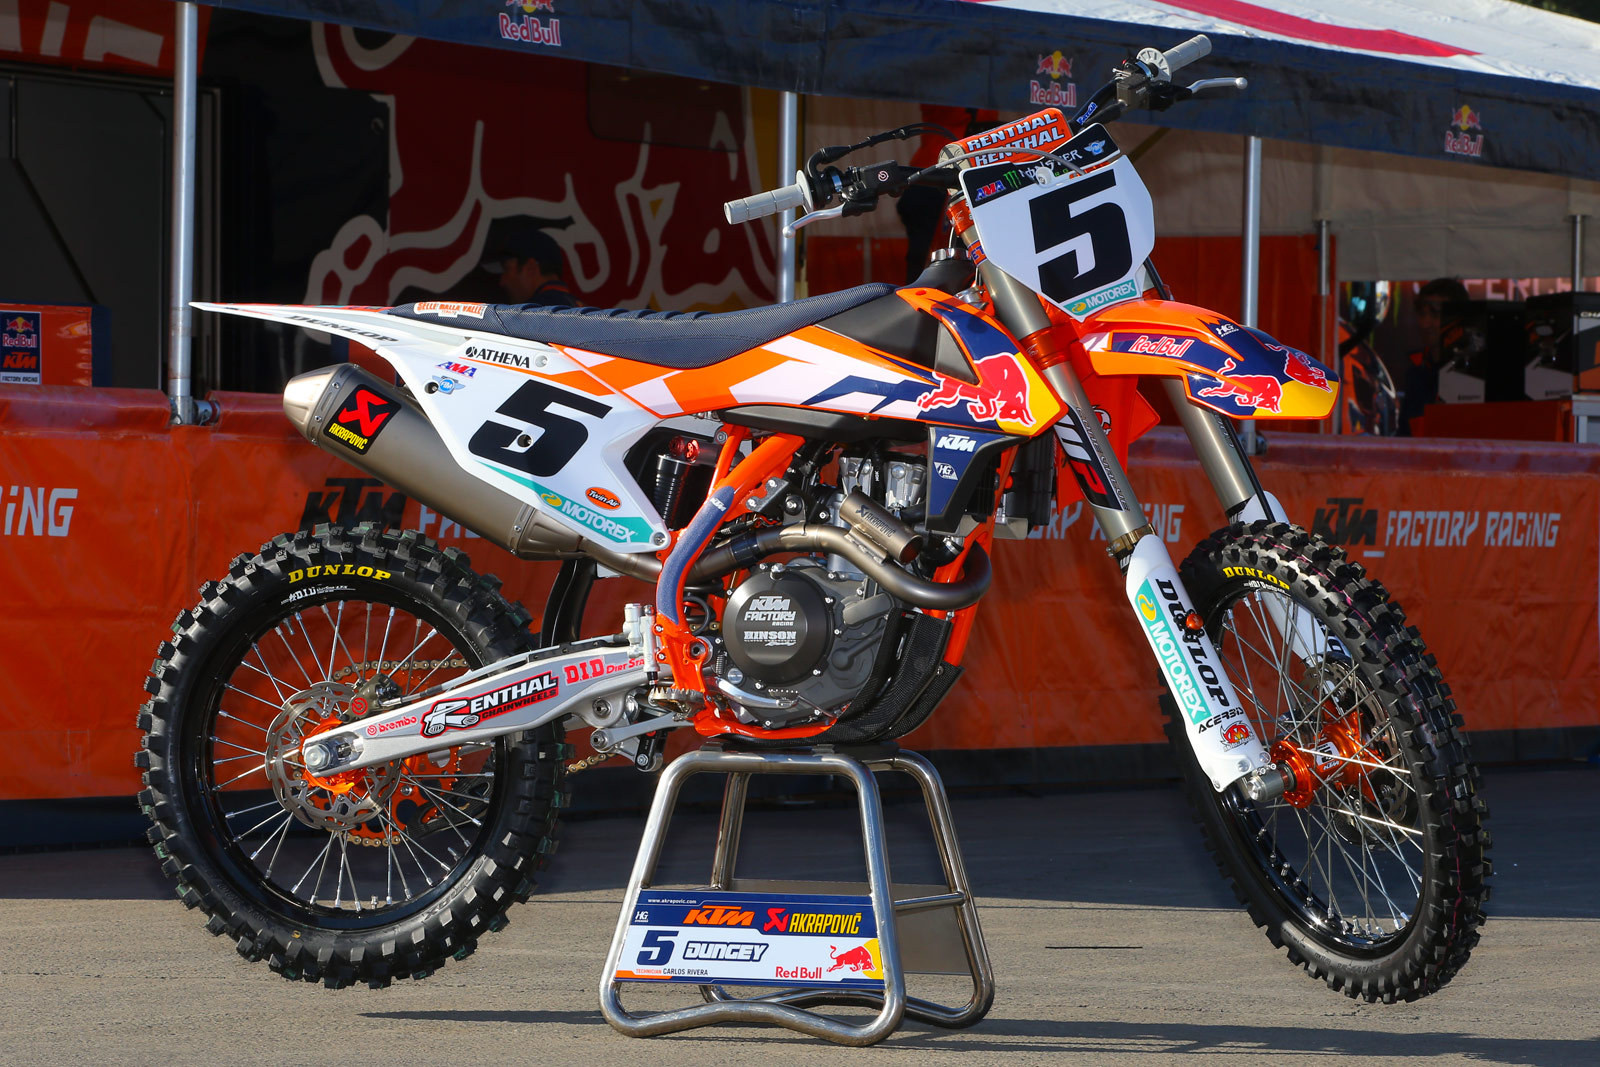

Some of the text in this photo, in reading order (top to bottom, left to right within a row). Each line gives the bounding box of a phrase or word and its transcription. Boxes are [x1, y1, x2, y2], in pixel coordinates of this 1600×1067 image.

[499, 13, 561, 46] Red Bull
[1030, 80, 1076, 107] Red Bull
[967, 114, 1057, 151] RENTHAL
[975, 180, 1006, 201] AMA
[1029, 169, 1132, 303] 5
[1086, 282, 1135, 308] MOTOREX
[286, 315, 399, 342] DUNLOP
[2, 333, 37, 348] Red Bull
[1128, 336, 1195, 357] Red Bull
[3, 352, 37, 368] KTM
[477, 349, 530, 368] ATHENA
[435, 361, 477, 379] AMA
[468, 379, 613, 477] 5
[936, 434, 976, 453] KTM
[299, 478, 407, 535] KTM
[561, 500, 636, 544] MOTOREX
[1310, 498, 1378, 546] KTM
[1385, 511, 1479, 547] FACTORY
[288, 564, 391, 584] DUNLOP
[1223, 566, 1290, 590] DUNLOP
[749, 596, 790, 610] KTM
[744, 611, 796, 621] FACTORY
[744, 631, 796, 640] HINSON
[1149, 621, 1206, 720] MOTOREX
[482, 689, 557, 719] CHAINWHEELS
[378, 716, 417, 732] brembo
[1198, 706, 1245, 734] ACERBIS
[635, 911, 649, 920] HG
[682, 905, 755, 926] KTM
[636, 930, 768, 966] 5 DUNGEY
[687, 968, 708, 976] RIVERA
[775, 966, 822, 980] Red Bull
